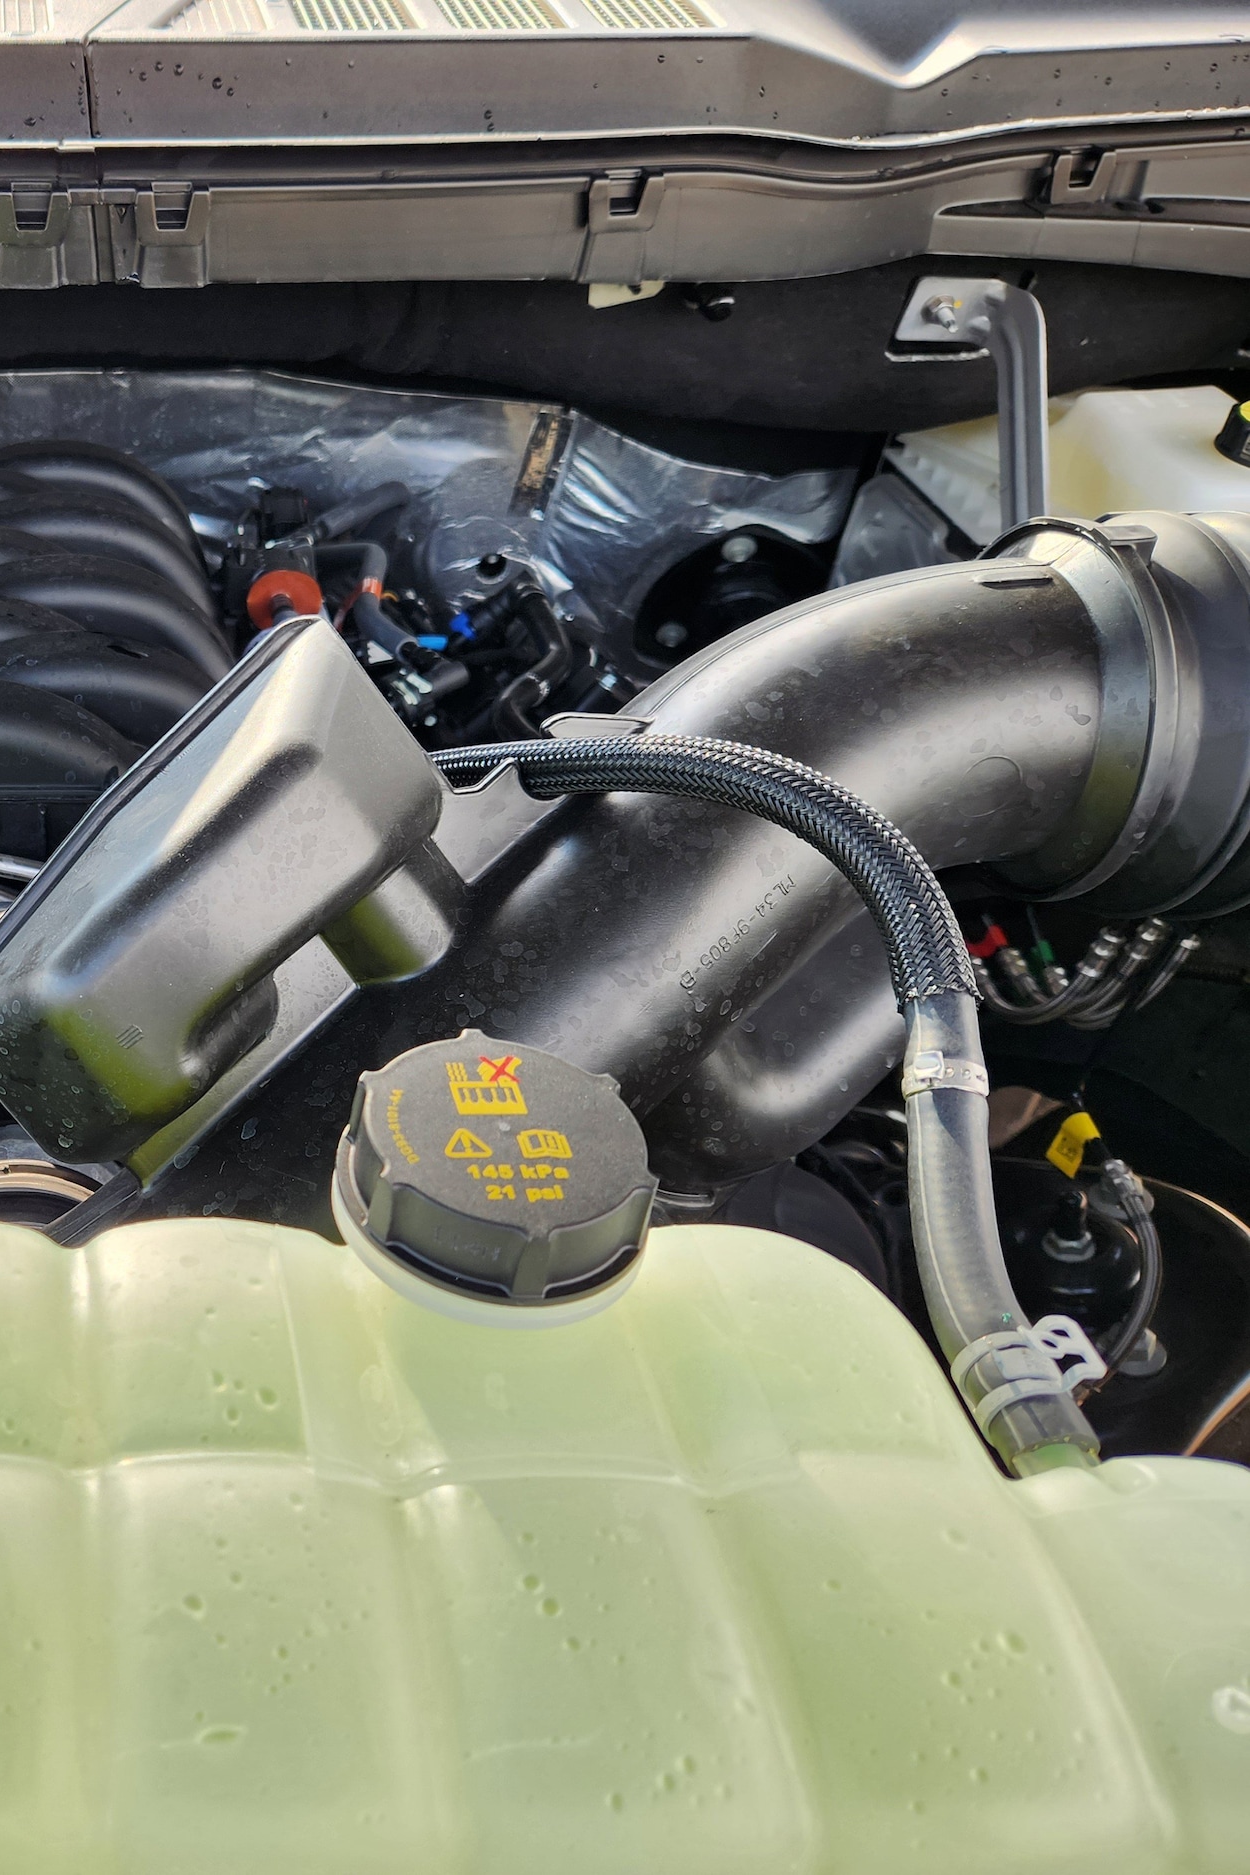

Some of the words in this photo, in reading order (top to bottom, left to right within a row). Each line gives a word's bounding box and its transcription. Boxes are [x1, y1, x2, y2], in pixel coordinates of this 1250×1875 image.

[467, 1164, 514, 1179] 145
[519, 1164, 569, 1179] kPa
[486, 1184, 516, 1200] 21
[526, 1184, 564, 1203] psi
